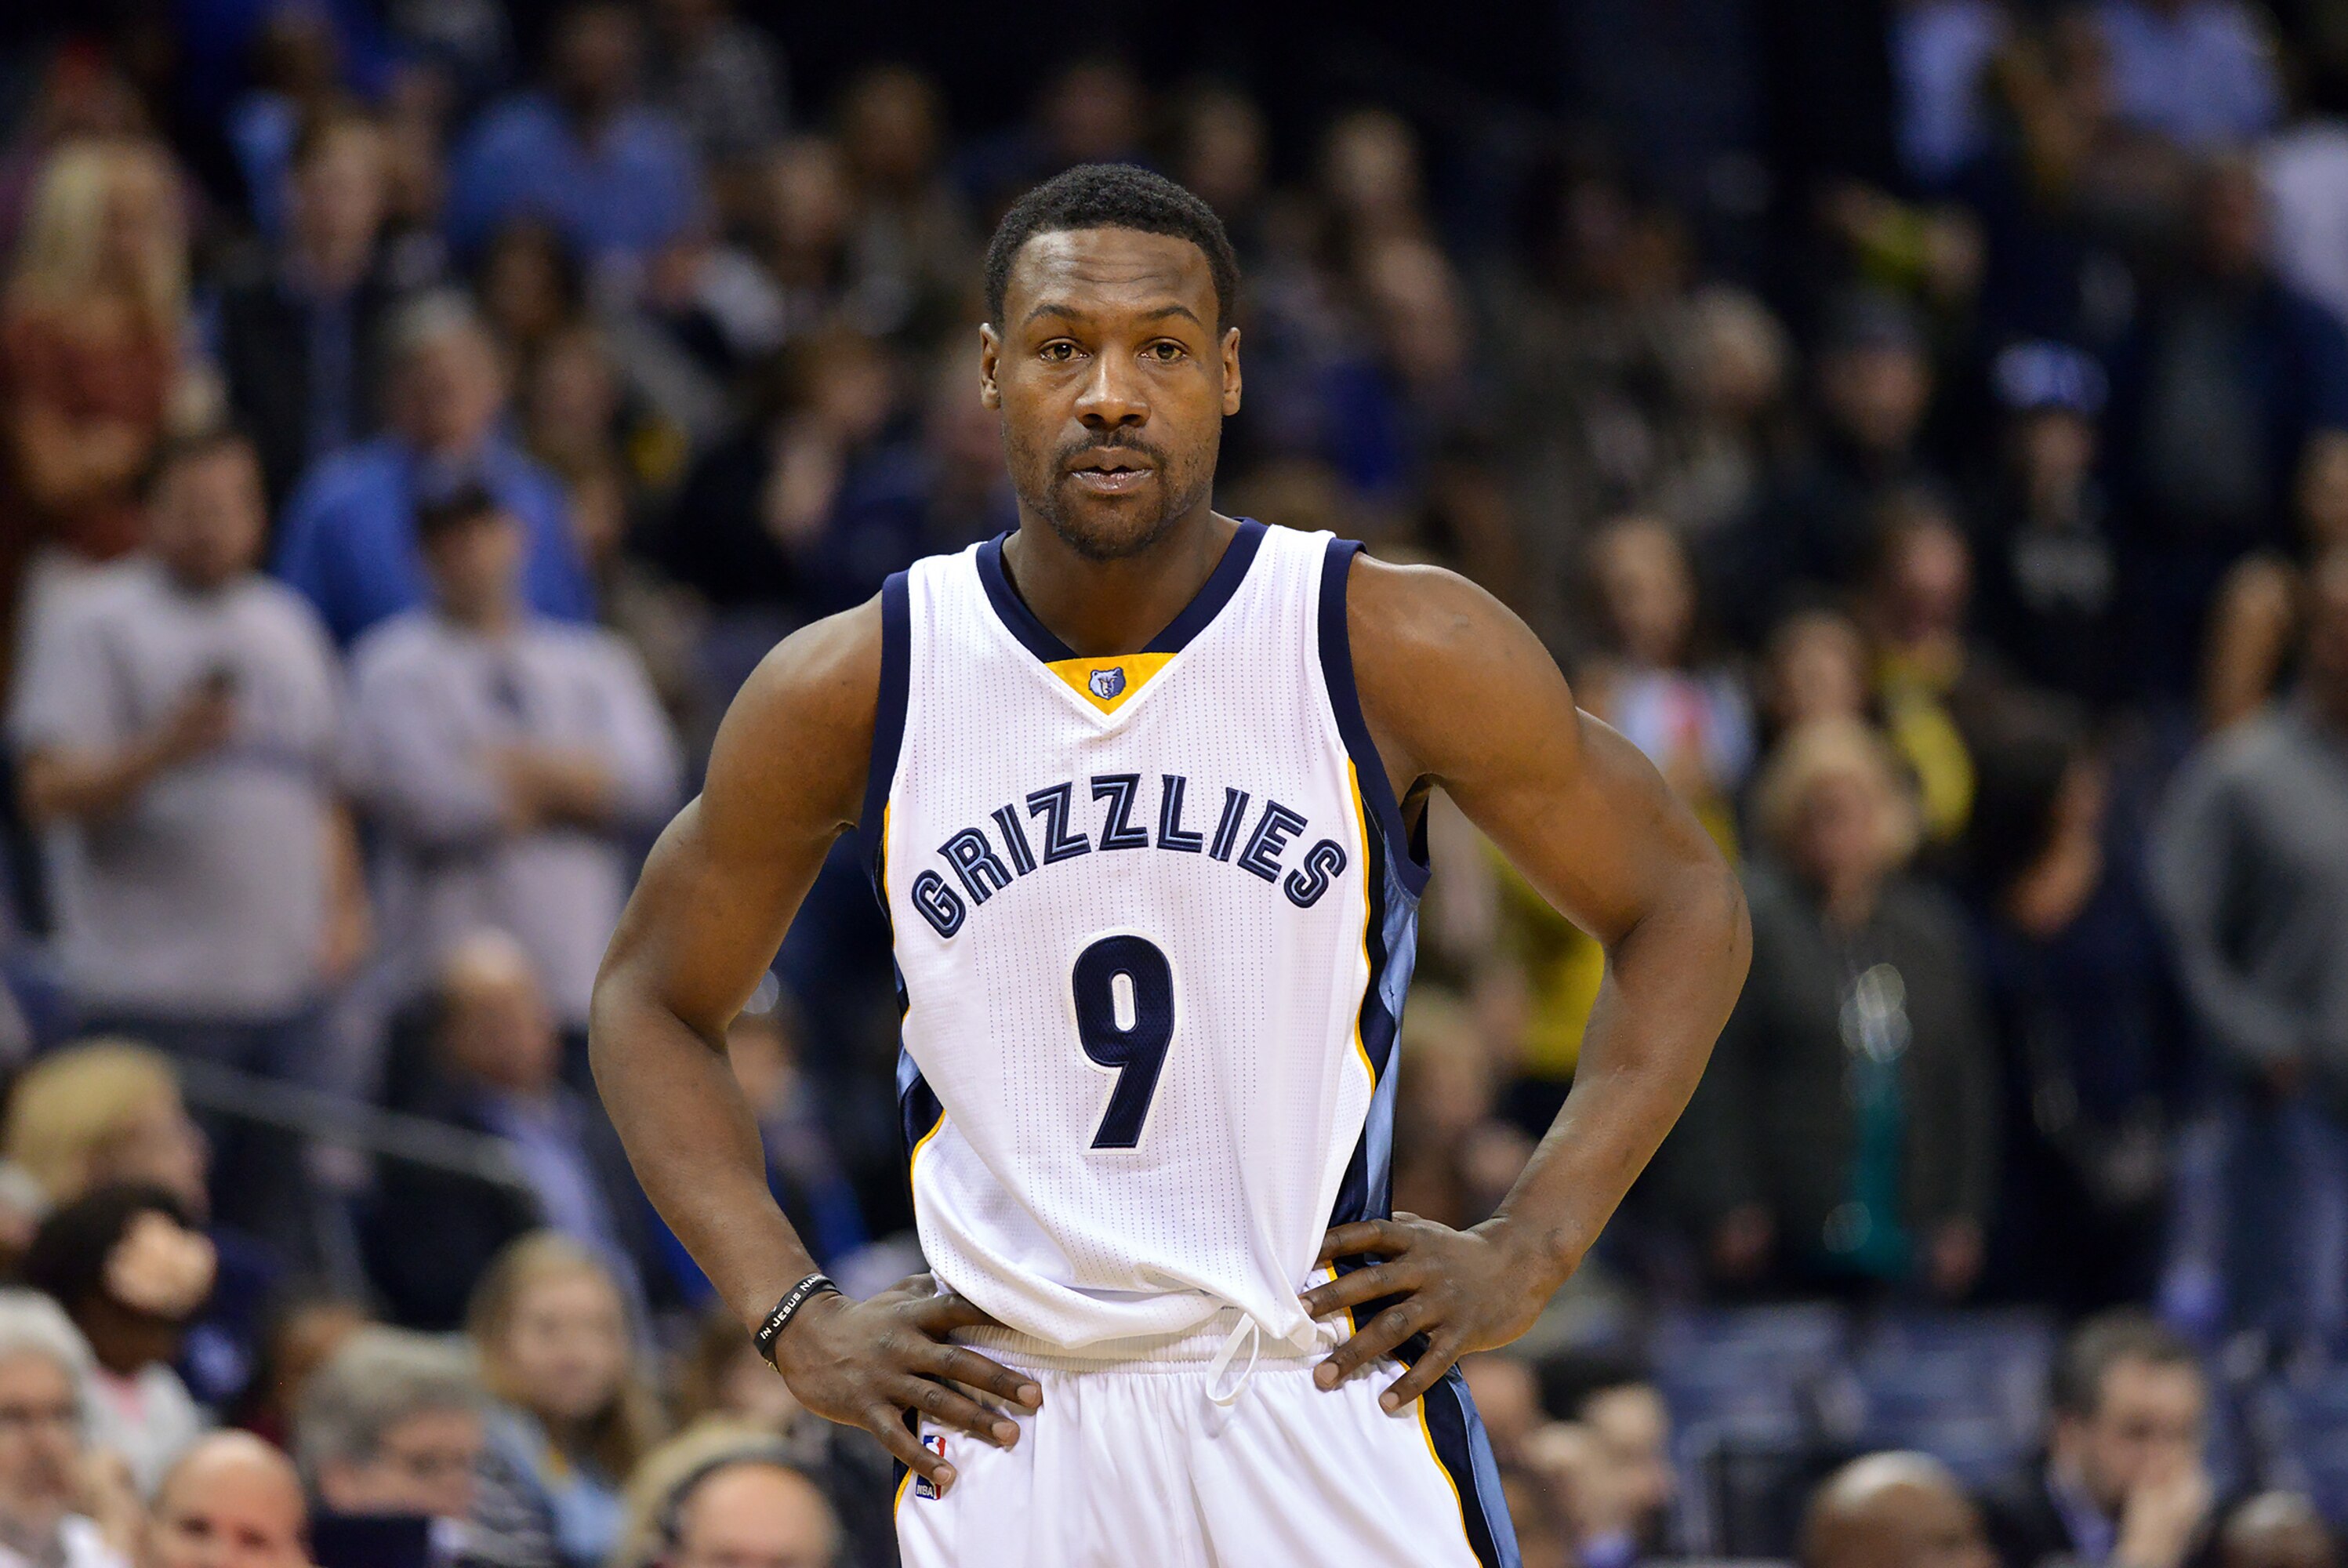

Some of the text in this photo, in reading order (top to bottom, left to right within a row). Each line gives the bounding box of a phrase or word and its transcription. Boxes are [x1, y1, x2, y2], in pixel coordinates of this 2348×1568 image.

[911, 773, 1348, 938] GRIZZLIES
[1072, 934, 1175, 1149] 9
[760, 1327, 772, 1339] IN
[772, 1292, 801, 1327] JESUS
[916, 1484, 934, 1497] NBA
